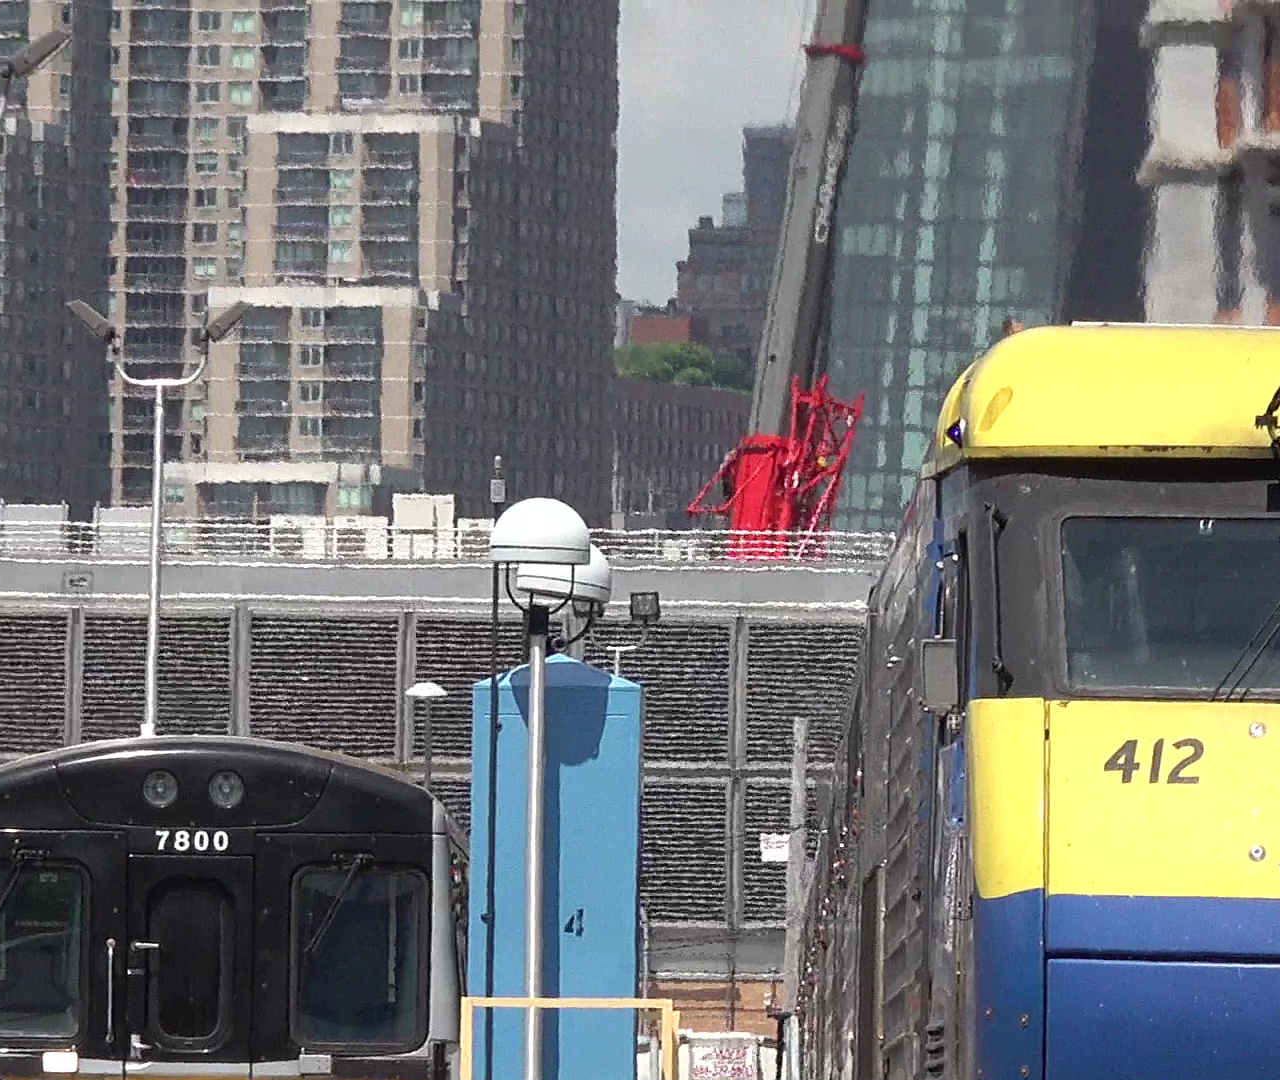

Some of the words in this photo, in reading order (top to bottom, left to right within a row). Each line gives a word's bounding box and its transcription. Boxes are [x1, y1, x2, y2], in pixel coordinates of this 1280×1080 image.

[1103, 737, 1205, 785] 412
[155, 830, 229, 851] 7800
[563, 908, 584, 937] 4
